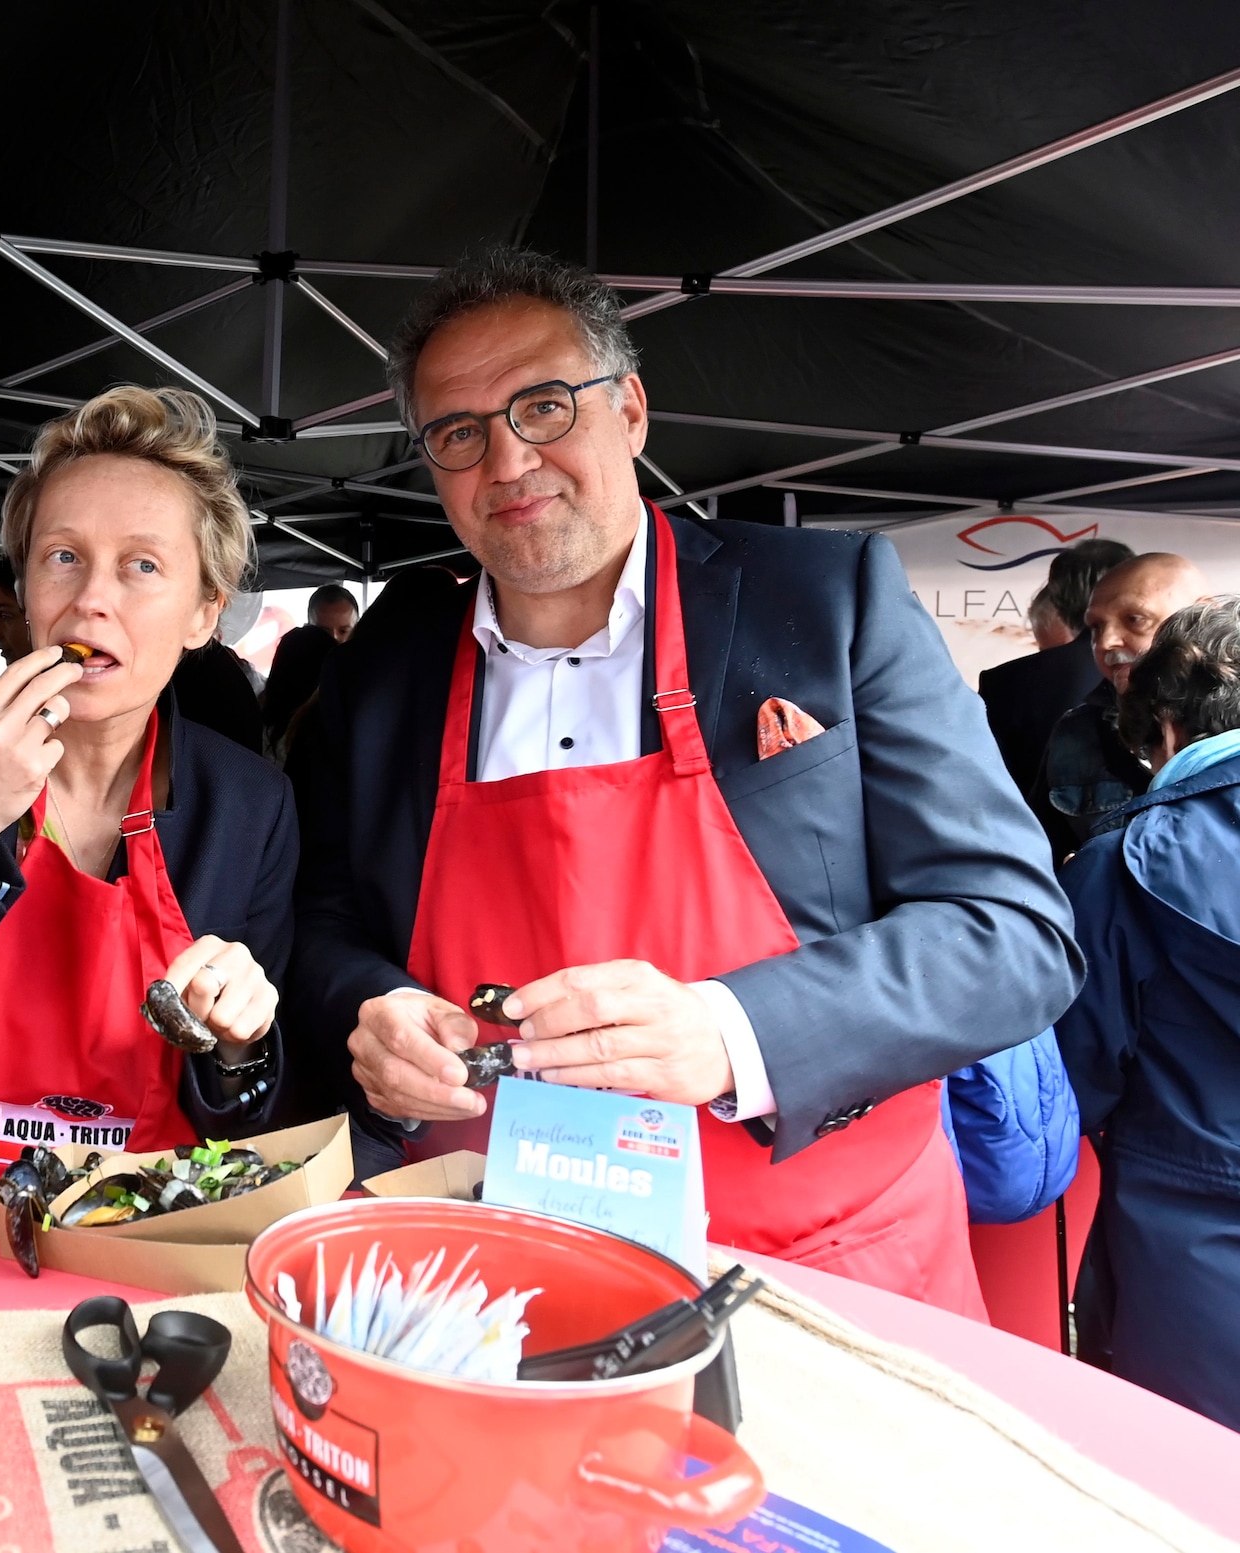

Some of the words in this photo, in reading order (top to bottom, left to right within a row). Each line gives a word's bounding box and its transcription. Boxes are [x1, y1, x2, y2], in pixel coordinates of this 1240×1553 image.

[911, 589, 1023, 618] LFA
[3, 1118, 56, 1142] AQUA
[516, 1138, 653, 1198] Moules
[303, 1423, 371, 1488] TRITON
